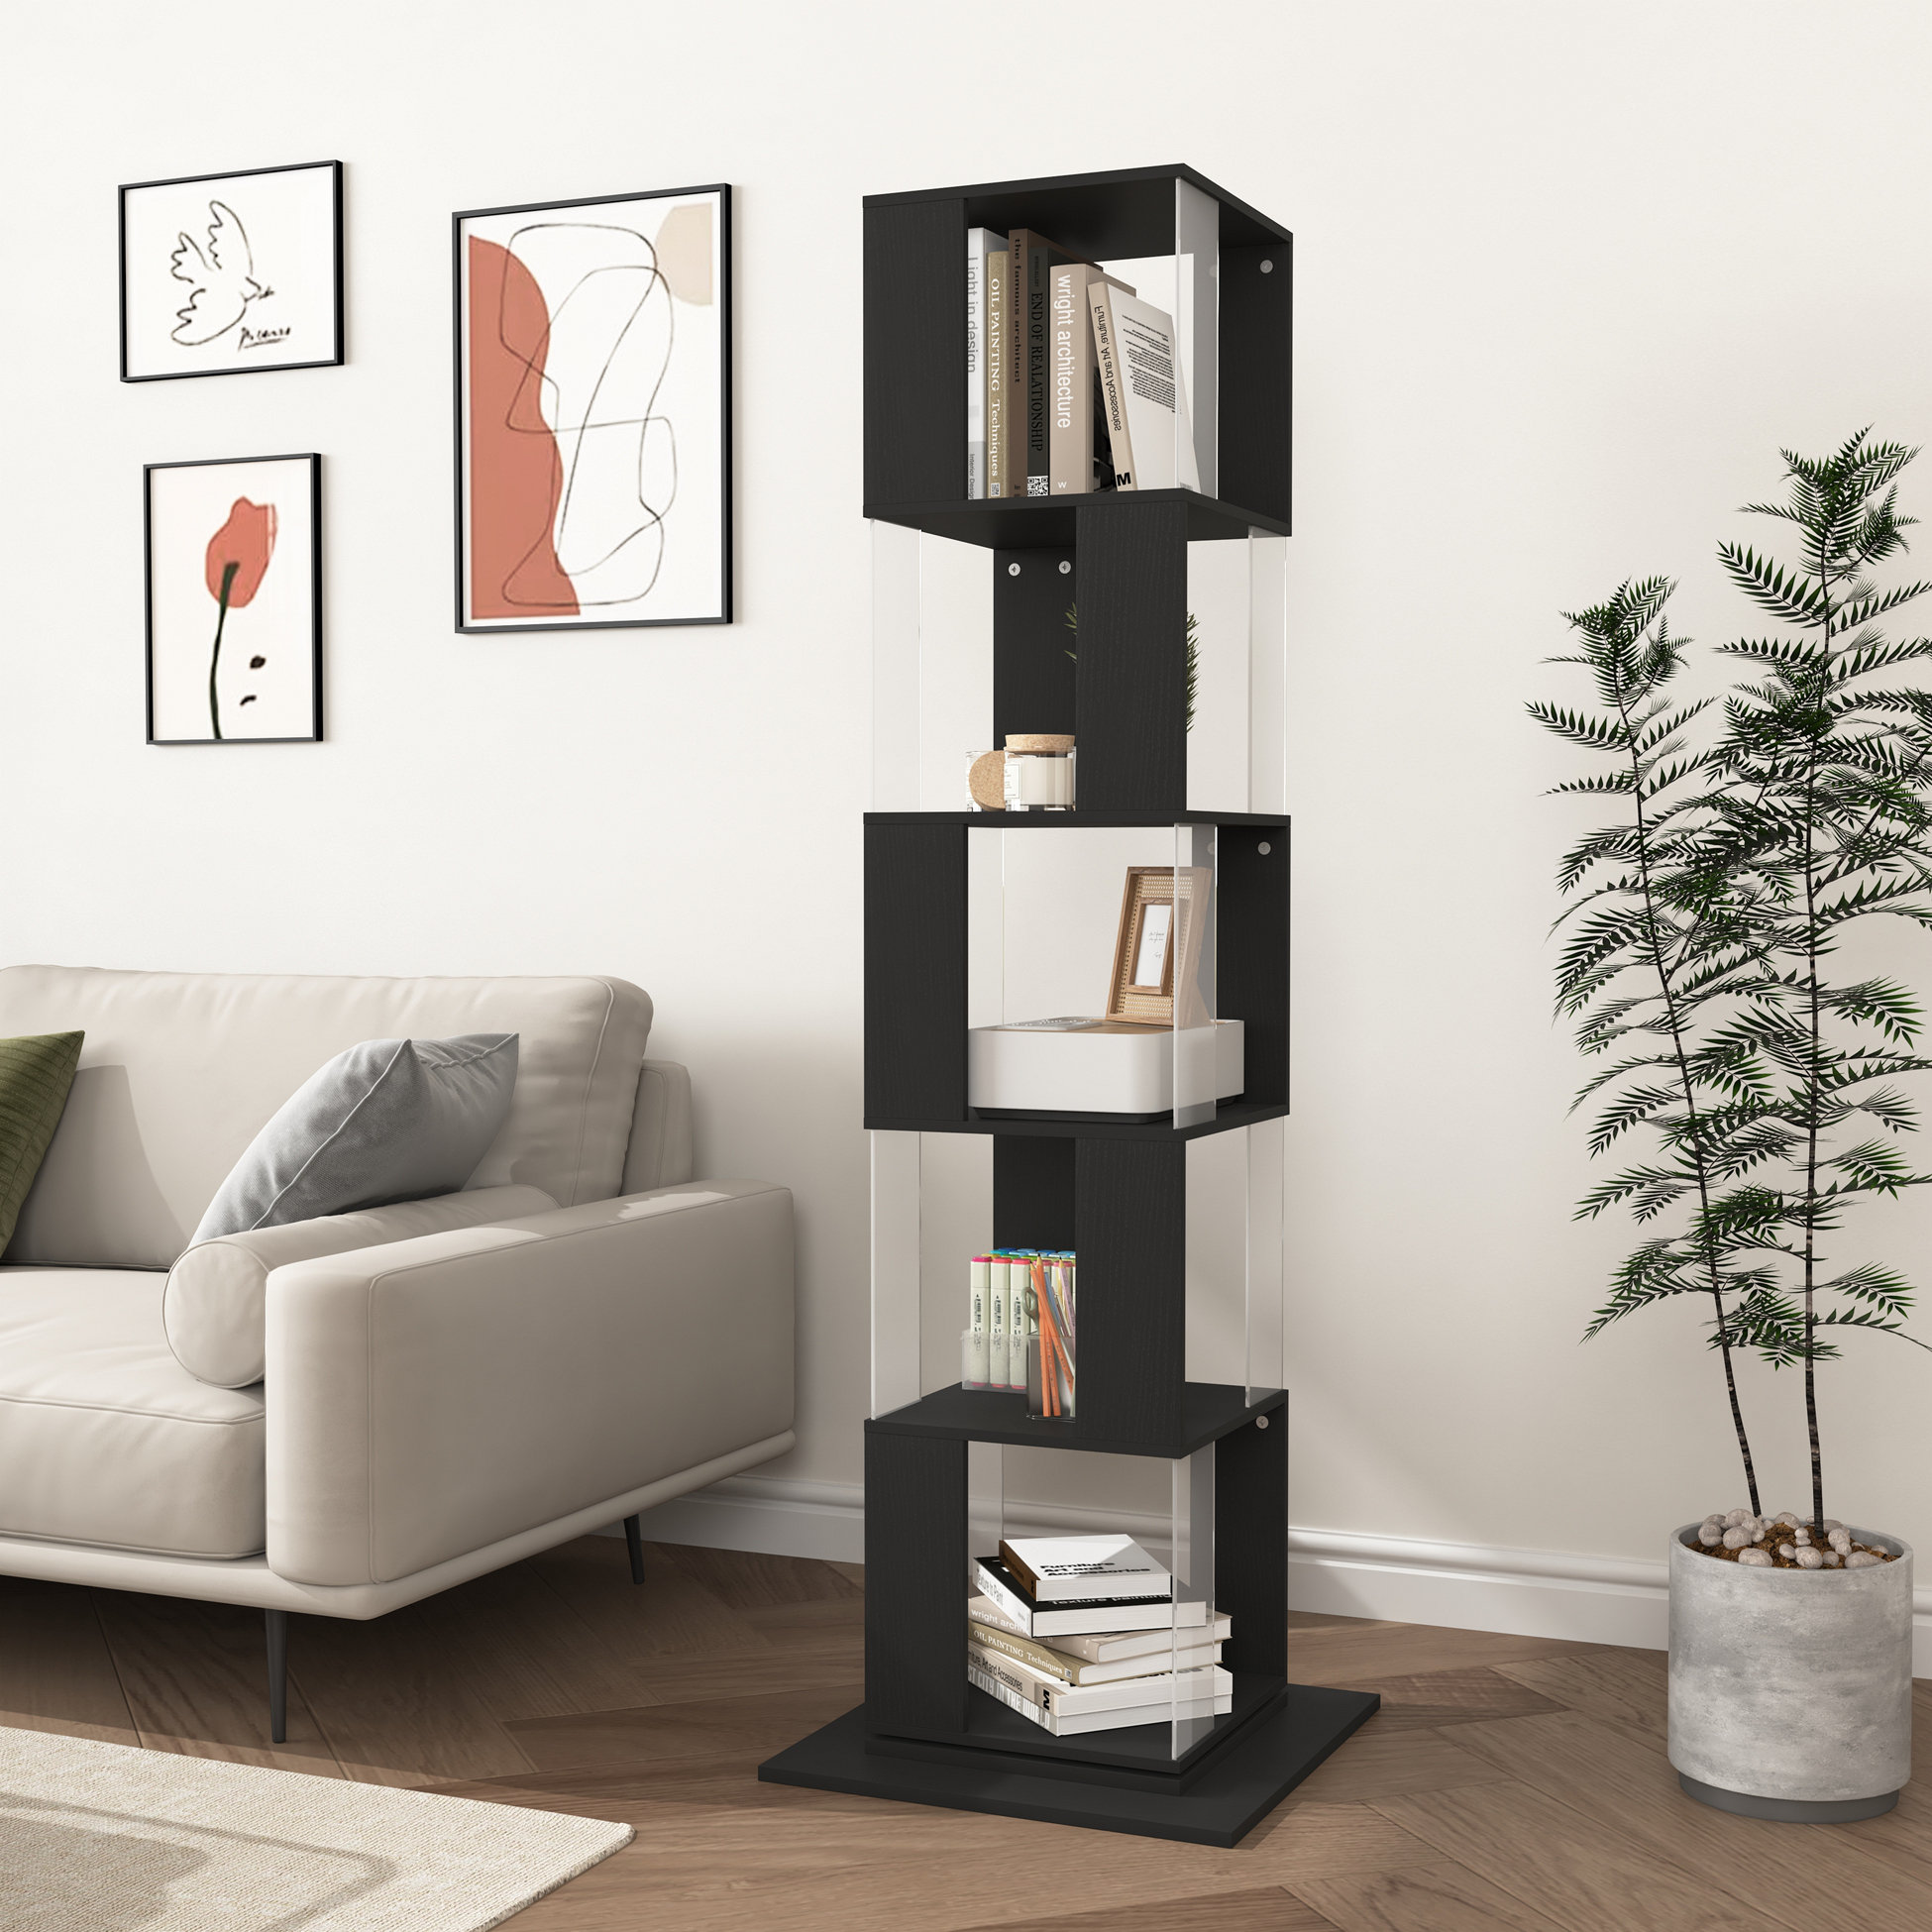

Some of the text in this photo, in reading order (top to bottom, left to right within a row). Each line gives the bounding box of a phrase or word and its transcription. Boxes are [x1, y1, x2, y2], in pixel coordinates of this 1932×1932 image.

[1054, 274, 1075, 428] wright architecture
[989, 278, 1001, 477] OIL PAINTING Techniques
[1030, 292, 1043, 452] END OF REALATIONSHIP
[1117, 473, 1131, 486] M
[971, 1609, 998, 1625] wright
[974, 1631, 1063, 1674] OIL PAINTING Techniques
[1006, 1688, 1021, 1710] THE
[1042, 1688, 1050, 1710] M
